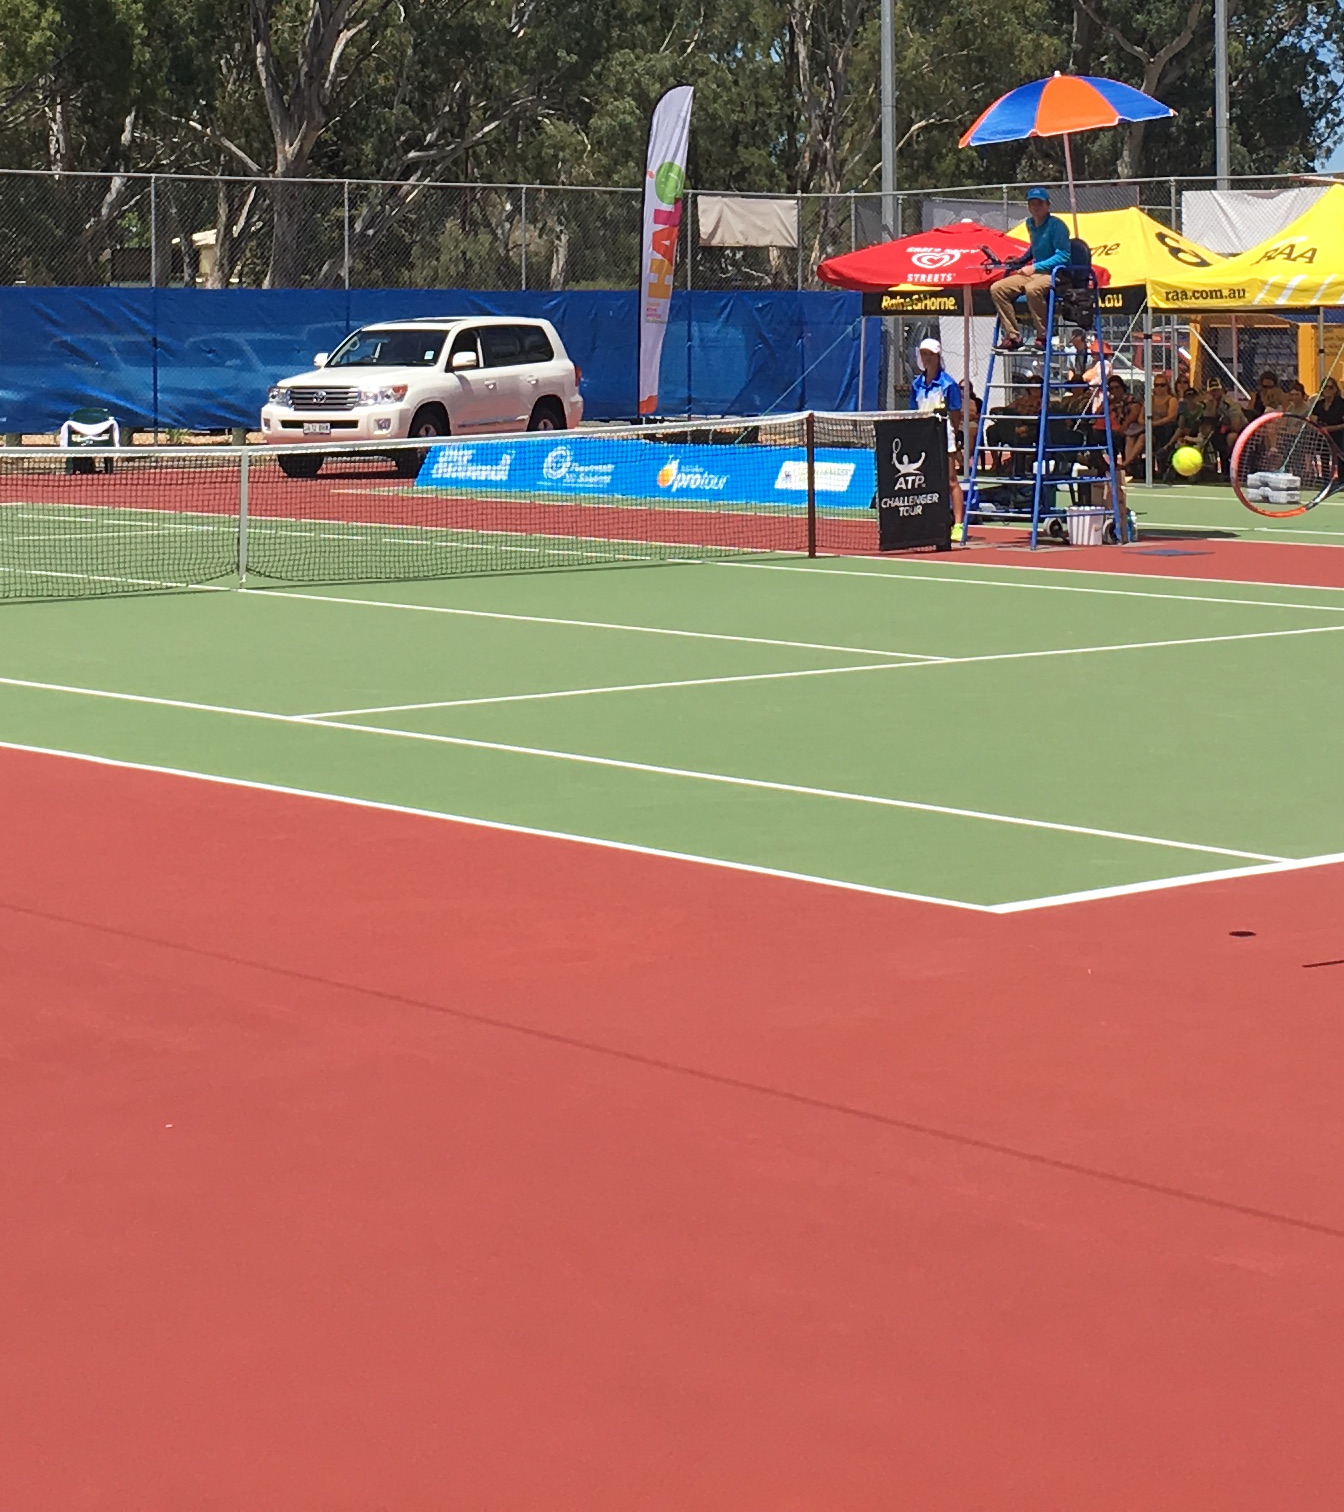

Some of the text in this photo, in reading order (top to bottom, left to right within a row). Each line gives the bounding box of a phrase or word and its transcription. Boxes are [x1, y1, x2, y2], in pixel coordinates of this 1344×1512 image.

[1249, 243, 1318, 266] RAA
[906, 272, 953, 283] STREETS
[1164, 286, 1247, 302] raa.com.au
[894, 475, 925, 490] ATP
[881, 493, 940, 508] CHALLENGER
[898, 505, 923, 517] TOUR
